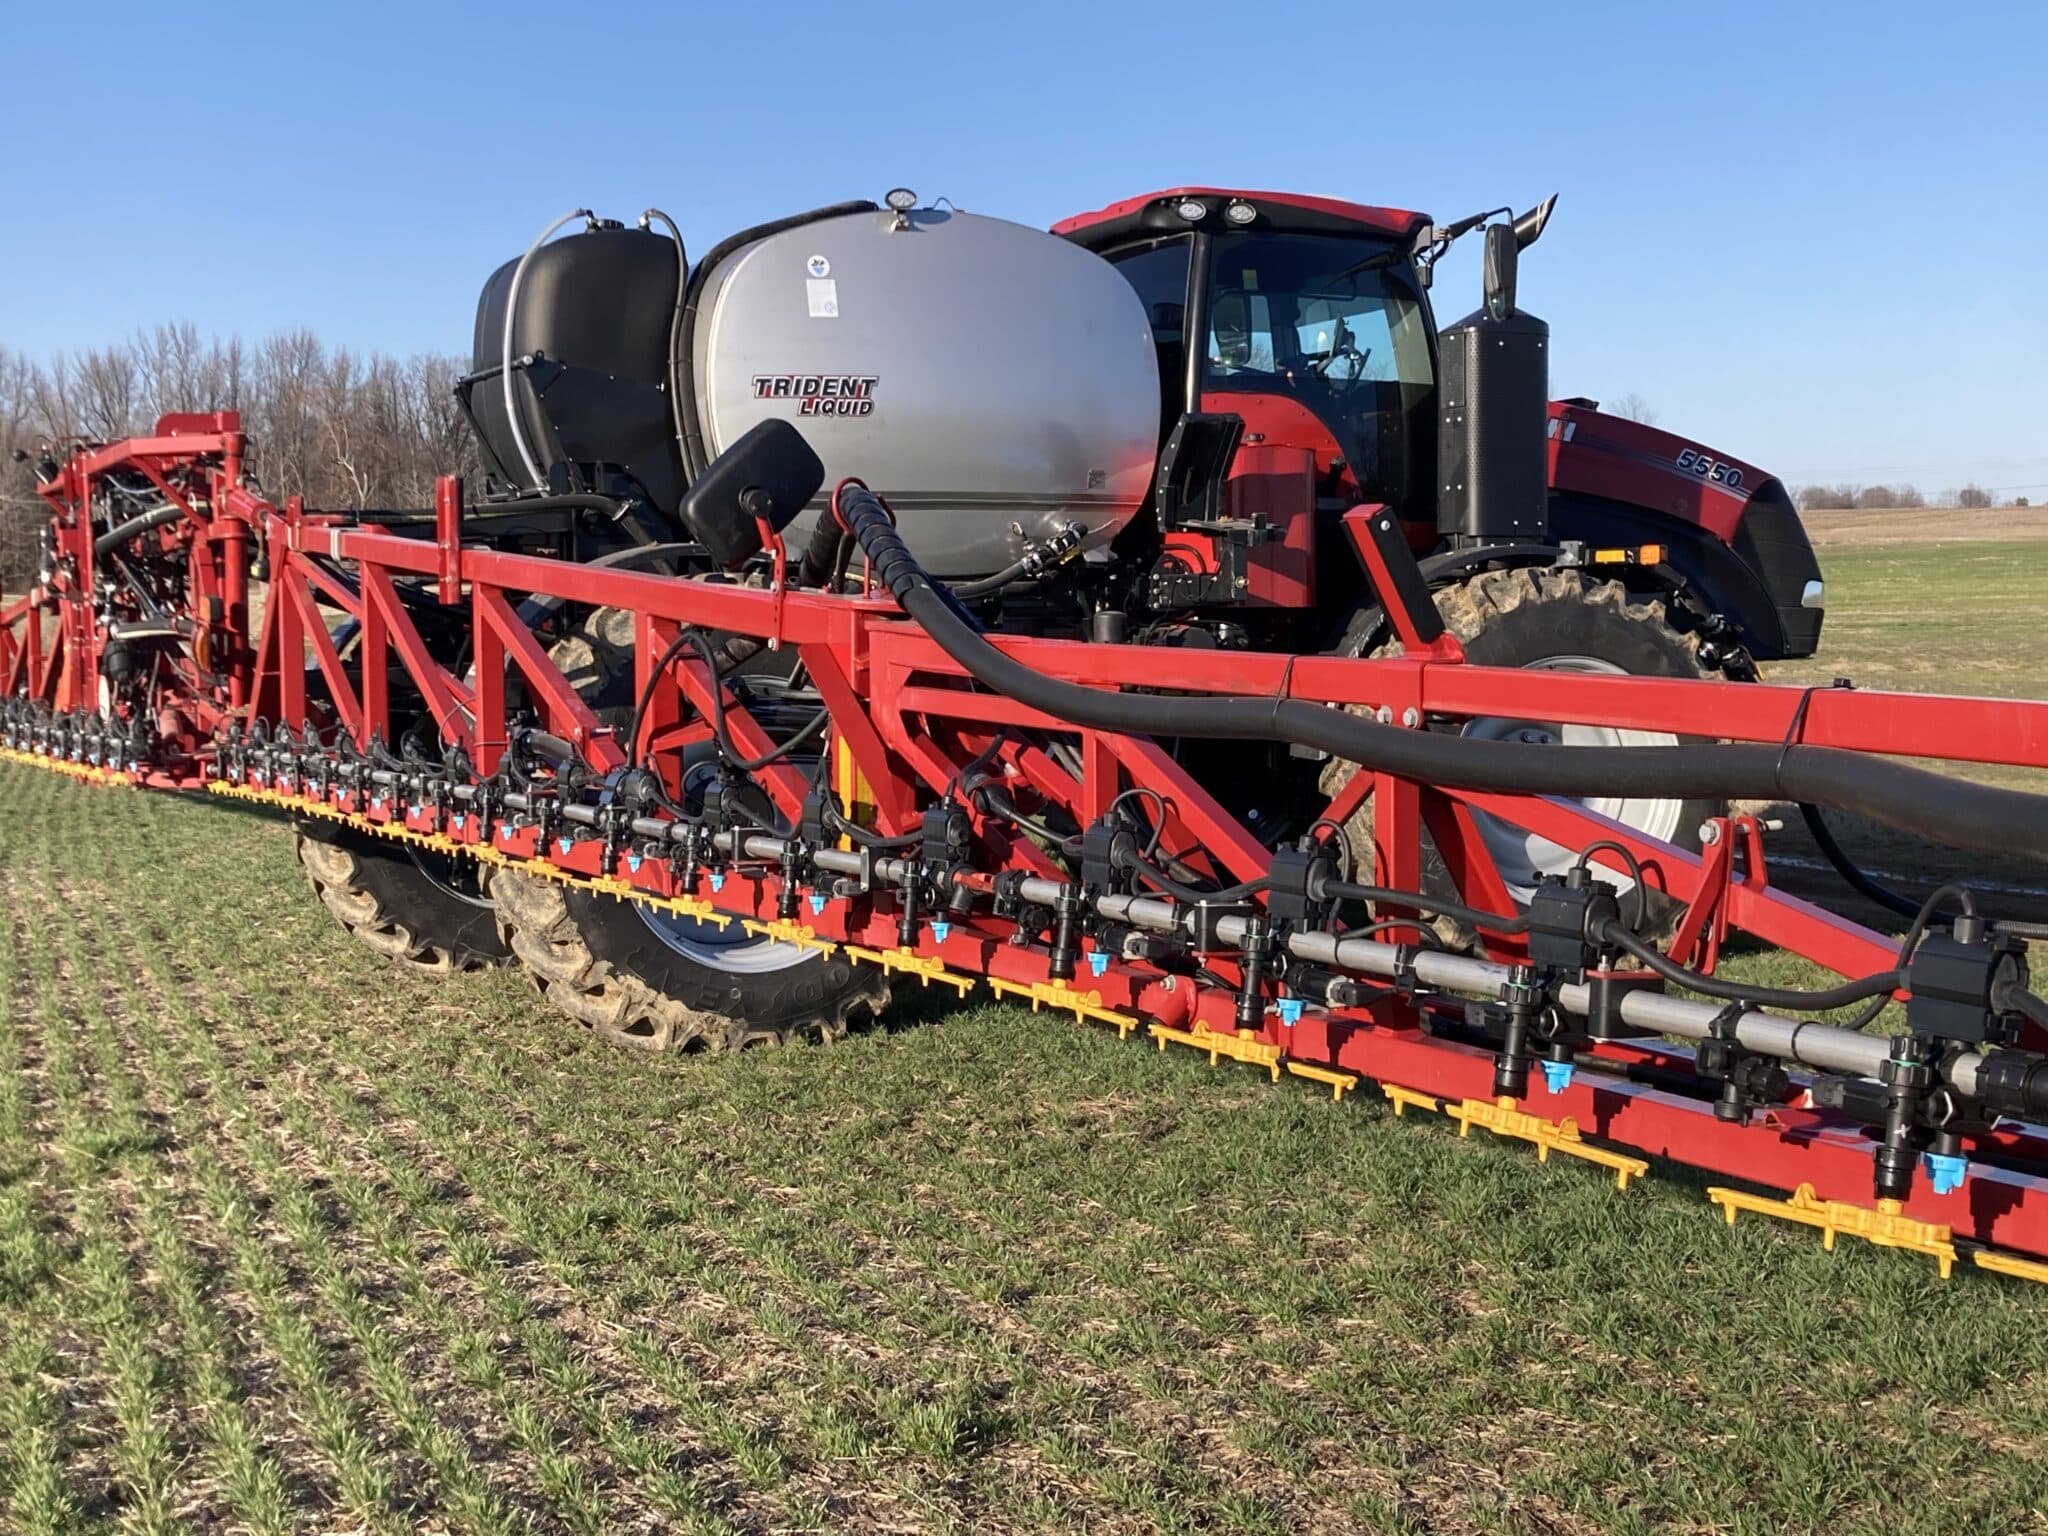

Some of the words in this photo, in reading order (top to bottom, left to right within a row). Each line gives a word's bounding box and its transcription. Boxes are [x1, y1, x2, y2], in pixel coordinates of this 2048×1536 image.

[753, 376, 878, 398] TRIDENT
[798, 399, 874, 417] LIQUID
[1676, 448, 1743, 488] 5550
